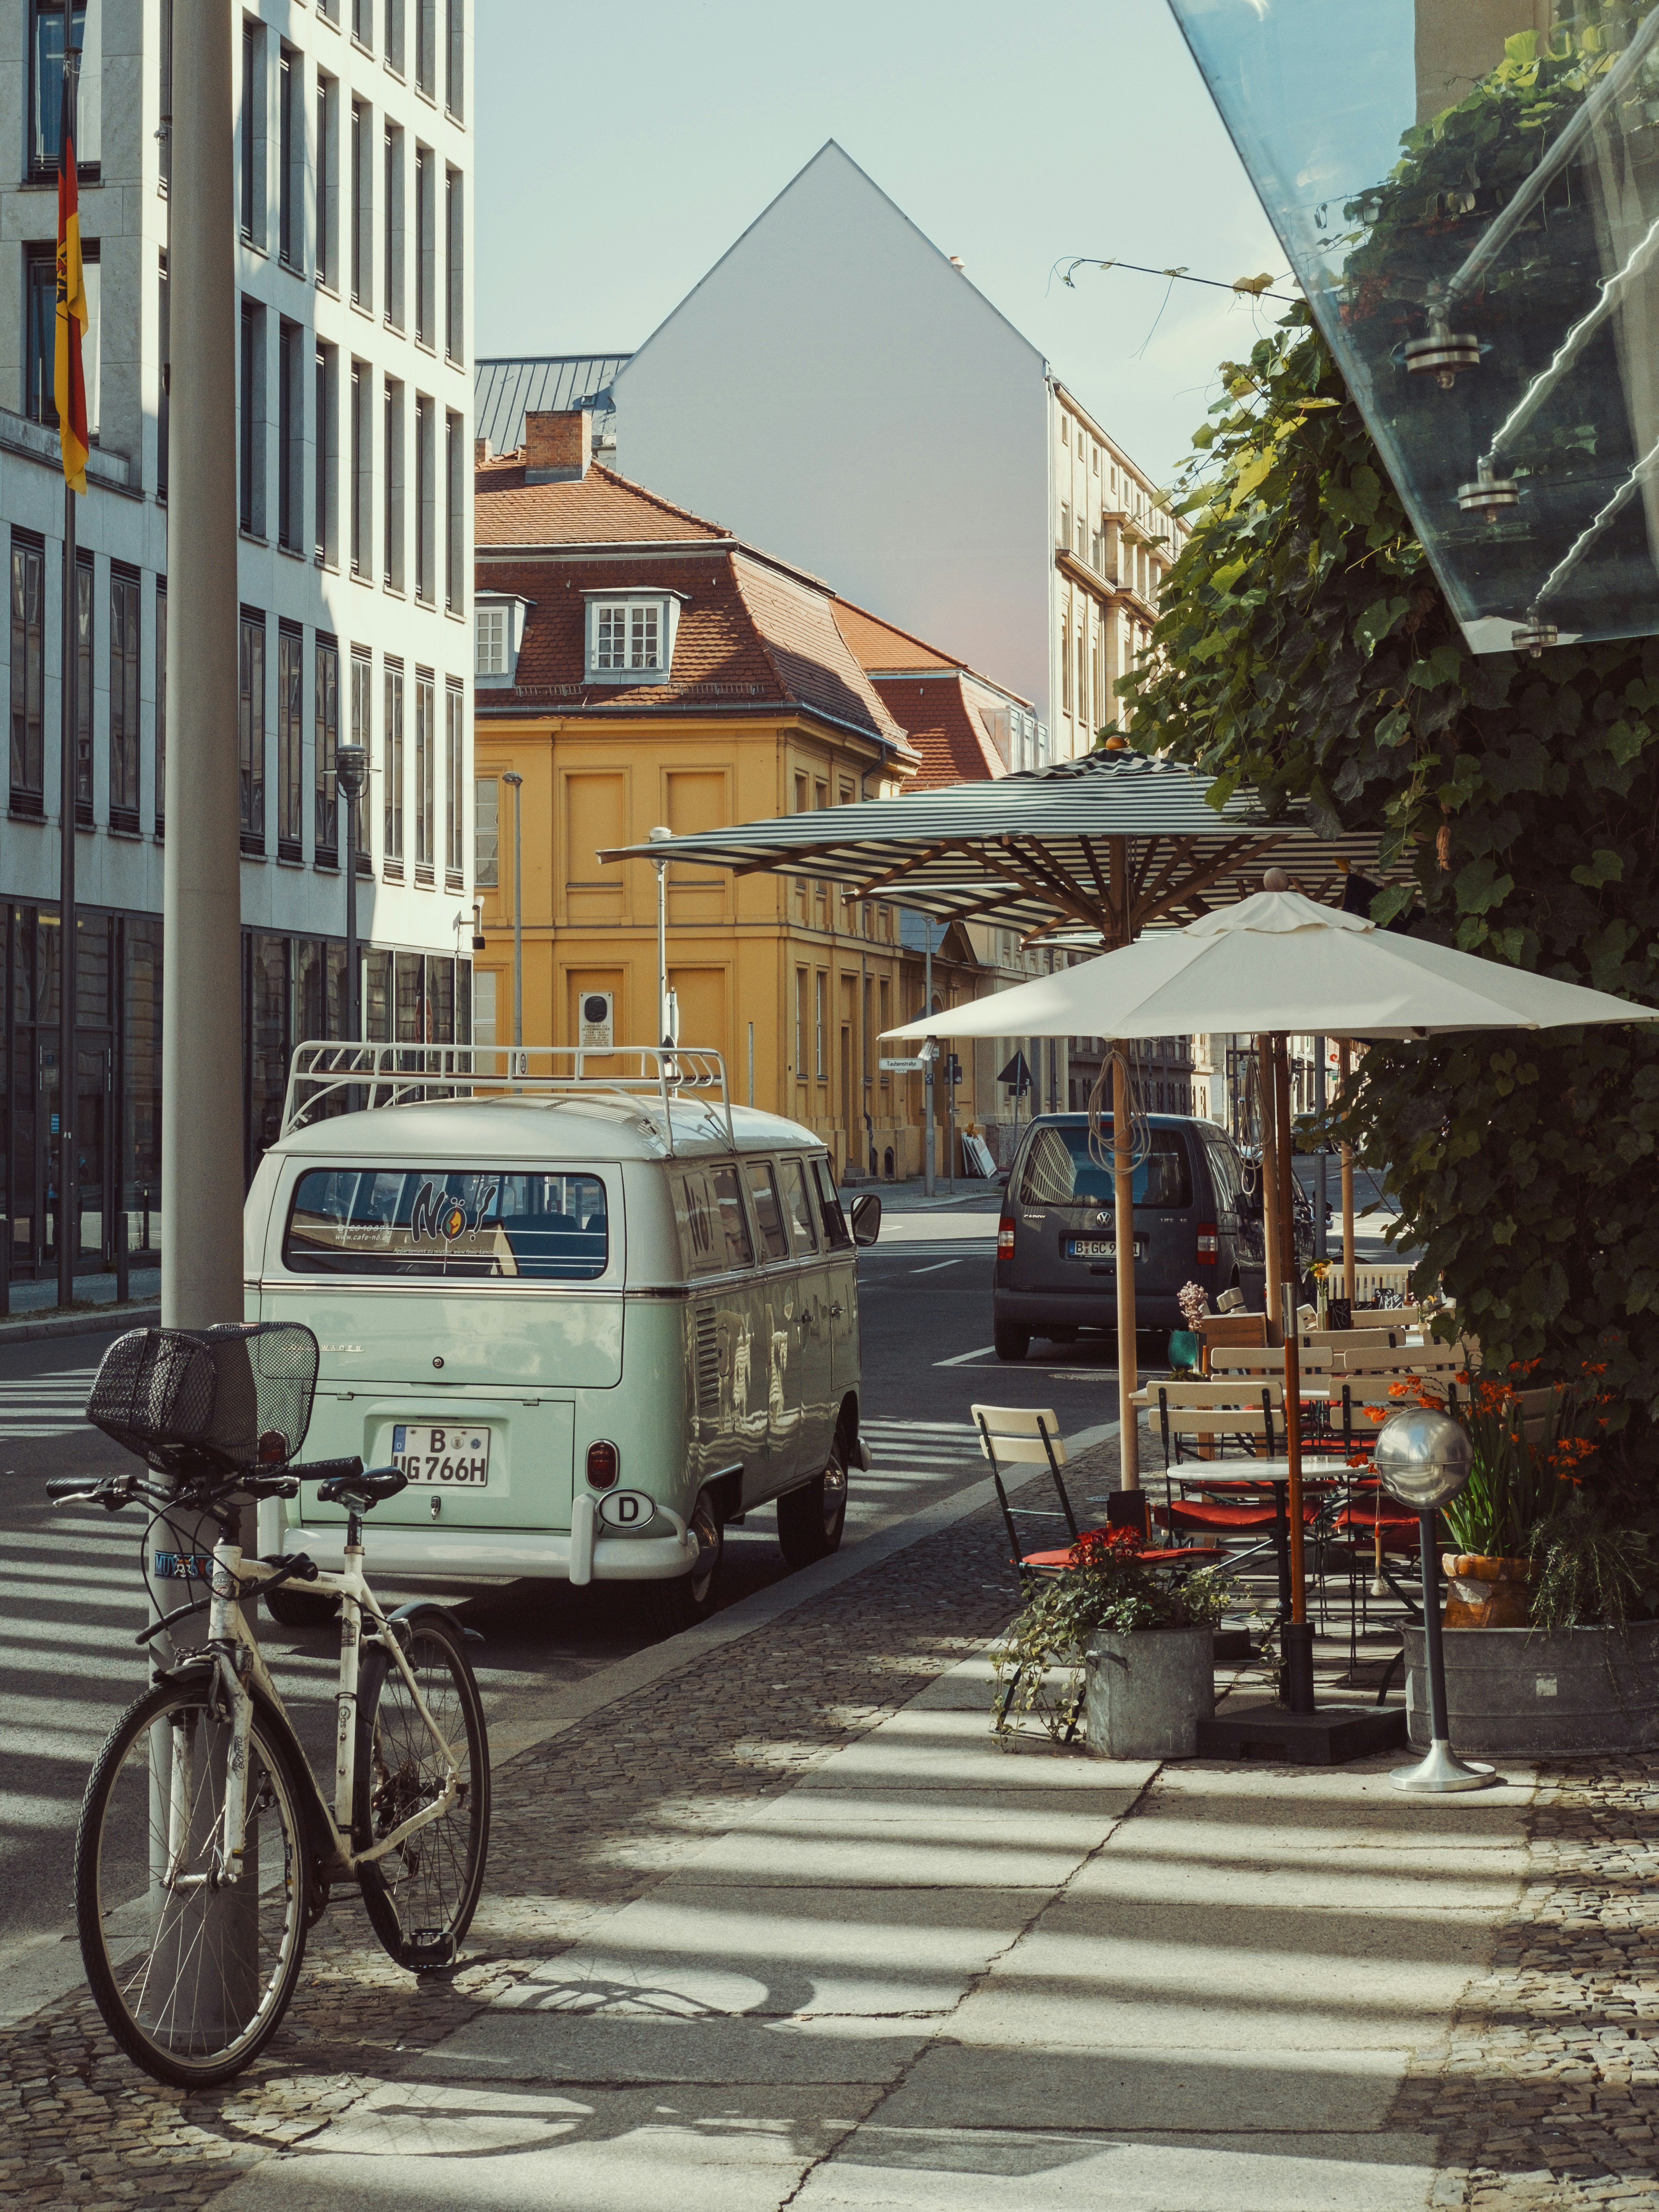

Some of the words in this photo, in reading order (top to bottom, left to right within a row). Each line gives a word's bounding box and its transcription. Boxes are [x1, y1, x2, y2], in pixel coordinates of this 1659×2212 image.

[1076, 1242, 1084, 1253] B
[1091, 1242, 1107, 1254] GC
[430, 1429, 446, 1453] B
[425, 1456, 486, 1482] 766H
[619, 1496, 639, 1522] D
